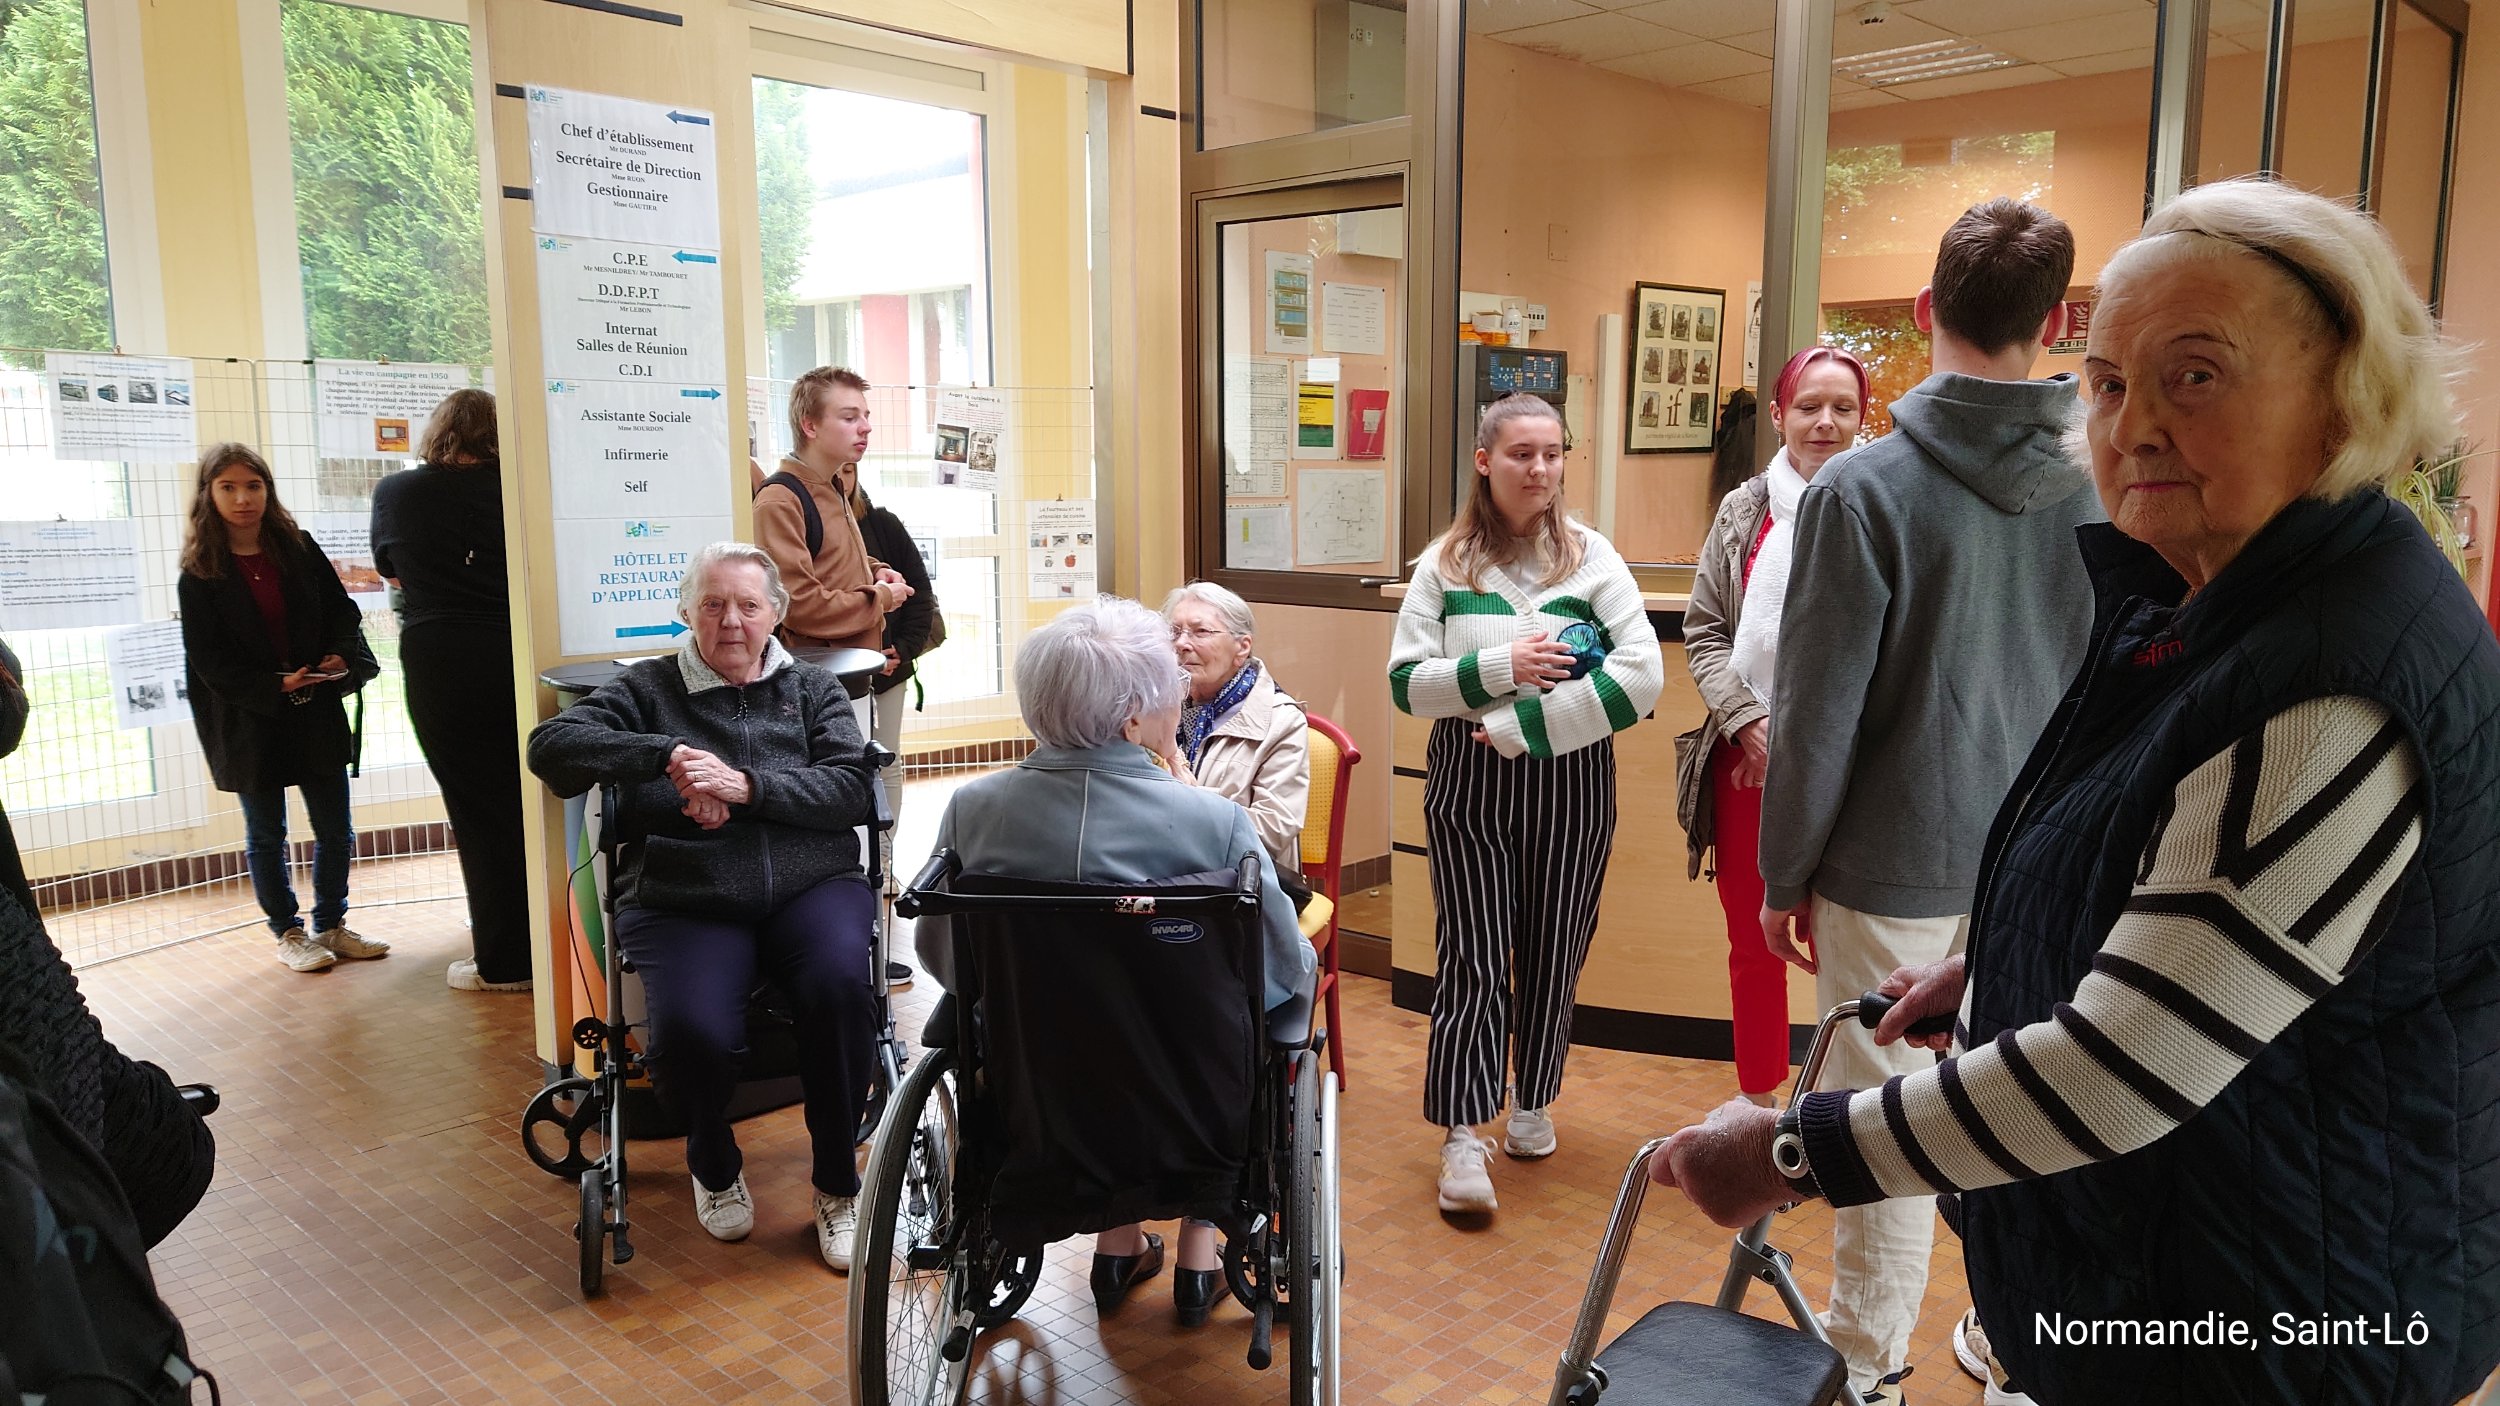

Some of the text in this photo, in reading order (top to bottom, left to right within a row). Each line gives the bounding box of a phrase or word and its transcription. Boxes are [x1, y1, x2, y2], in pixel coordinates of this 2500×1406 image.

[561, 123, 694, 153] Chef d'établissement
[620, 147, 646, 156] DURAND
[556, 150, 702, 181] Secrétaire de Direction
[587, 182, 668, 202] Gestionnaire
[628, 202, 658, 211] GAUTIER
[613, 252, 648, 266] C.P.E
[598, 284, 660, 300] D.D.F.P.T
[606, 322, 657, 336] Internat
[576, 338, 688, 356] Salles de Réunion
[619, 364, 652, 376] C.D.I
[1665, 388, 1684, 426] if
[580, 409, 691, 423] Assistante Sociale
[604, 449, 668, 460] Infirmerie
[624, 480, 648, 492] Self
[614, 552, 687, 566] HÔTEL ET
[600, 570, 685, 584] RESTAURA
[592, 588, 682, 604] D'APPLICAT
[1152, 924, 1194, 934] INVACARE
